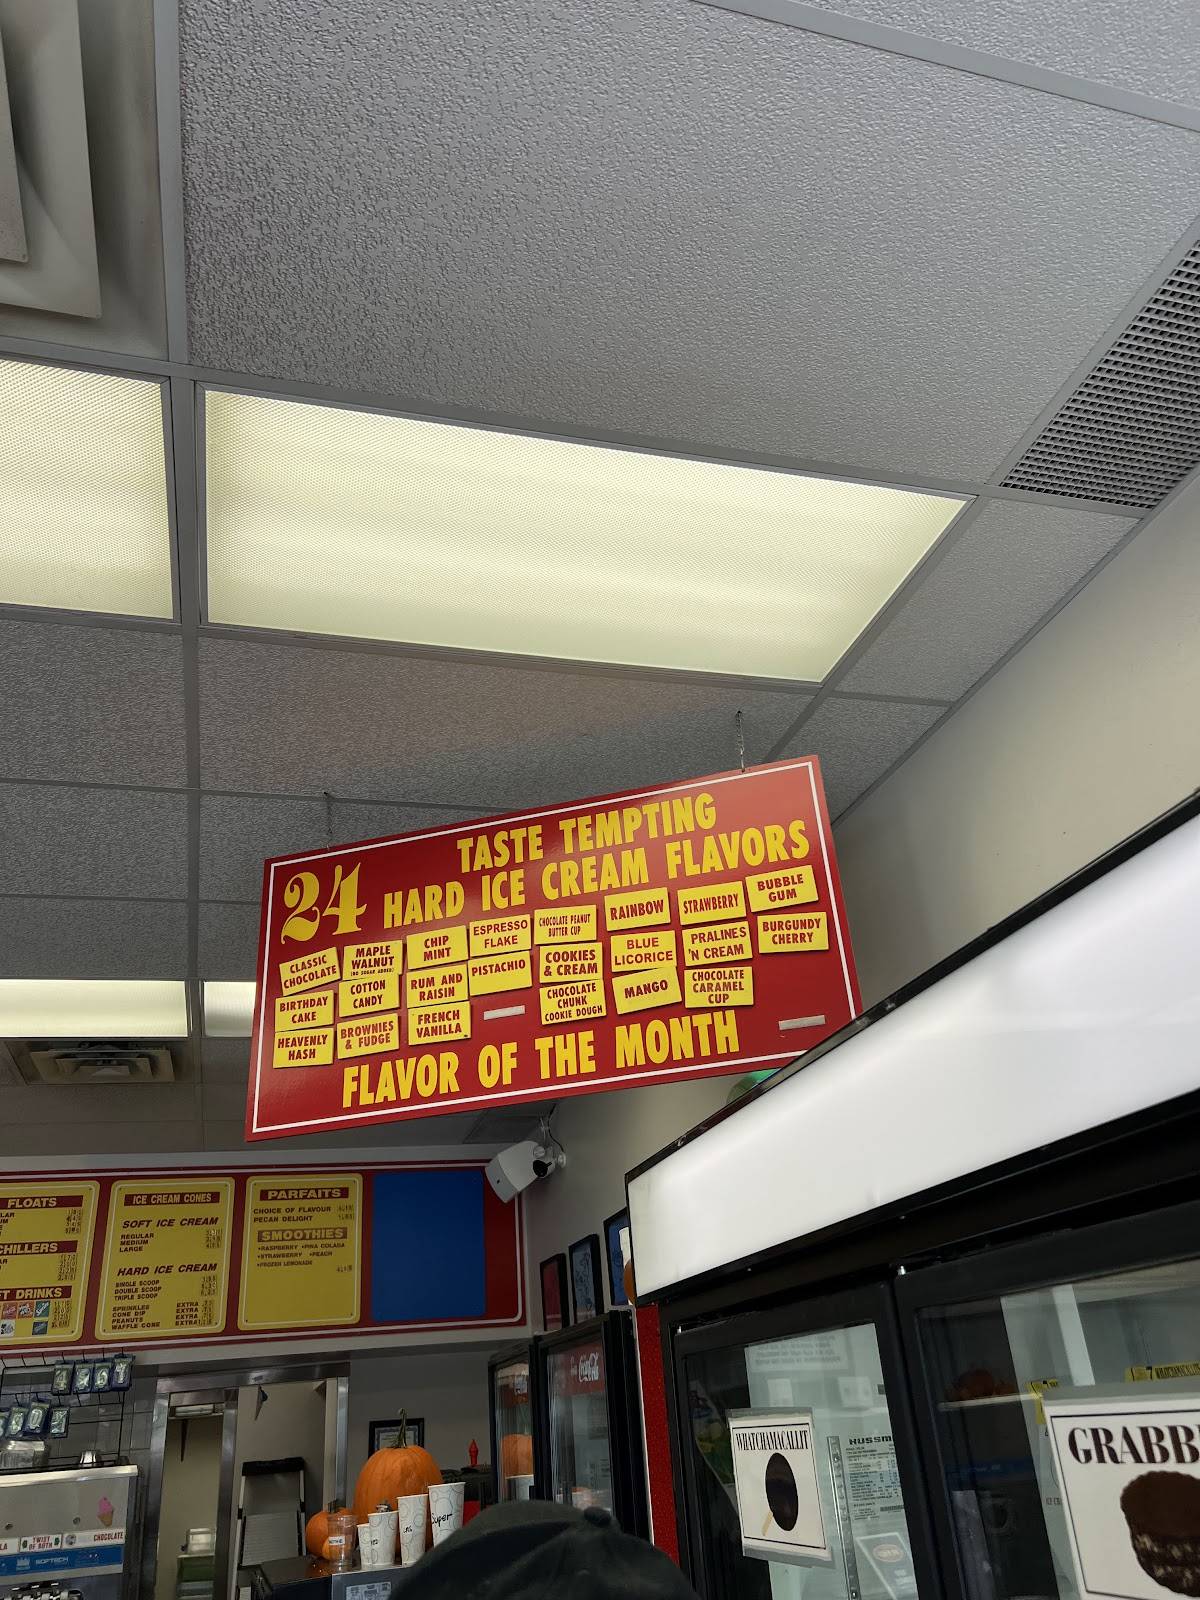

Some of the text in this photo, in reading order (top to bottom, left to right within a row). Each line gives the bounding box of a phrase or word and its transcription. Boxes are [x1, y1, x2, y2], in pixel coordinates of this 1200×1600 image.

[457, 793, 716, 873] TASTE TEMPTING
[281, 820, 810, 944] 24 HARD ICE CREAM FLAVORS
[757, 874, 803, 891] BUBBLE
[769, 888, 797, 902] GUM
[610, 900, 664, 921] RAINBOW
[683, 894, 739, 914] STRAWBERRY
[539, 913, 590, 926] CHOCOLATE PEANUT
[763, 918, 821, 932] BURGUNDY
[473, 920, 528, 936] ESPRESSO
[549, 925, 581, 937] BUTTER CUP
[691, 926, 747, 944] PRALINES
[424, 935, 449, 949] CHIP
[484, 935, 518, 948] FLAKE
[627, 937, 659, 950] BLUE
[772, 932, 814, 944] CHERRY
[356, 945, 391, 958] MAPLE
[424, 948, 451, 962] MINT
[546, 950, 596, 963] COOKIES
[614, 951, 673, 966] LICORICE
[688, 944, 744, 961] 'N CREAM
[290, 954, 327, 974] CLASSIC
[351, 955, 395, 969] WALNUT
[472, 959, 526, 977] PISTACHIO
[544, 963, 598, 976] & CREAM
[692, 969, 745, 981] CHOCOLATE
[283, 965, 337, 989] CHOCOLATE
[410, 973, 463, 990] RUM AND
[350, 980, 386, 995] COTTON
[419, 986, 455, 1001] RAISIN
[547, 983, 596, 999] CHOCOLATE
[624, 979, 668, 999] MANGO
[692, 981, 745, 992] CARAMEL
[280, 996, 328, 1012] BIRTHDAY
[353, 995, 383, 1009] CANDY
[557, 995, 587, 1009] CHUNK
[708, 992, 729, 1004] CUP
[292, 1011, 317, 1023] CAKE
[418, 1010, 460, 1025] FRENCH
[545, 1005, 602, 1021] COOKIE DOUGH
[341, 1021, 394, 1039] BROWNIES
[416, 1022, 462, 1038] VANILLA
[278, 1034, 328, 1048] HEAVENLY
[345, 1034, 391, 1049] & FUDGE
[288, 1047, 316, 1060] HASH
[342, 1010, 739, 1108] FLAVOR OF THE MONTH
[133, 1192, 211, 1205] ICE CREAM CONES
[268, 1188, 342, 1200] PARFAITS
[8, 1198, 57, 1208] FLOATS
[123, 1217, 218, 1228] SOFT ICE CREAM
[261, 1228, 344, 1241] SMOOTHIES
[118, 1263, 217, 1276] HARD ICE CREAM
[16, 1288, 62, 1300] DRINKS
[736, 1430, 808, 1450] WHATCHAMACALLIT
[1068, 1423, 1200, 1465] GRABB
[94, 1531, 124, 1542] CHOCOLATE
